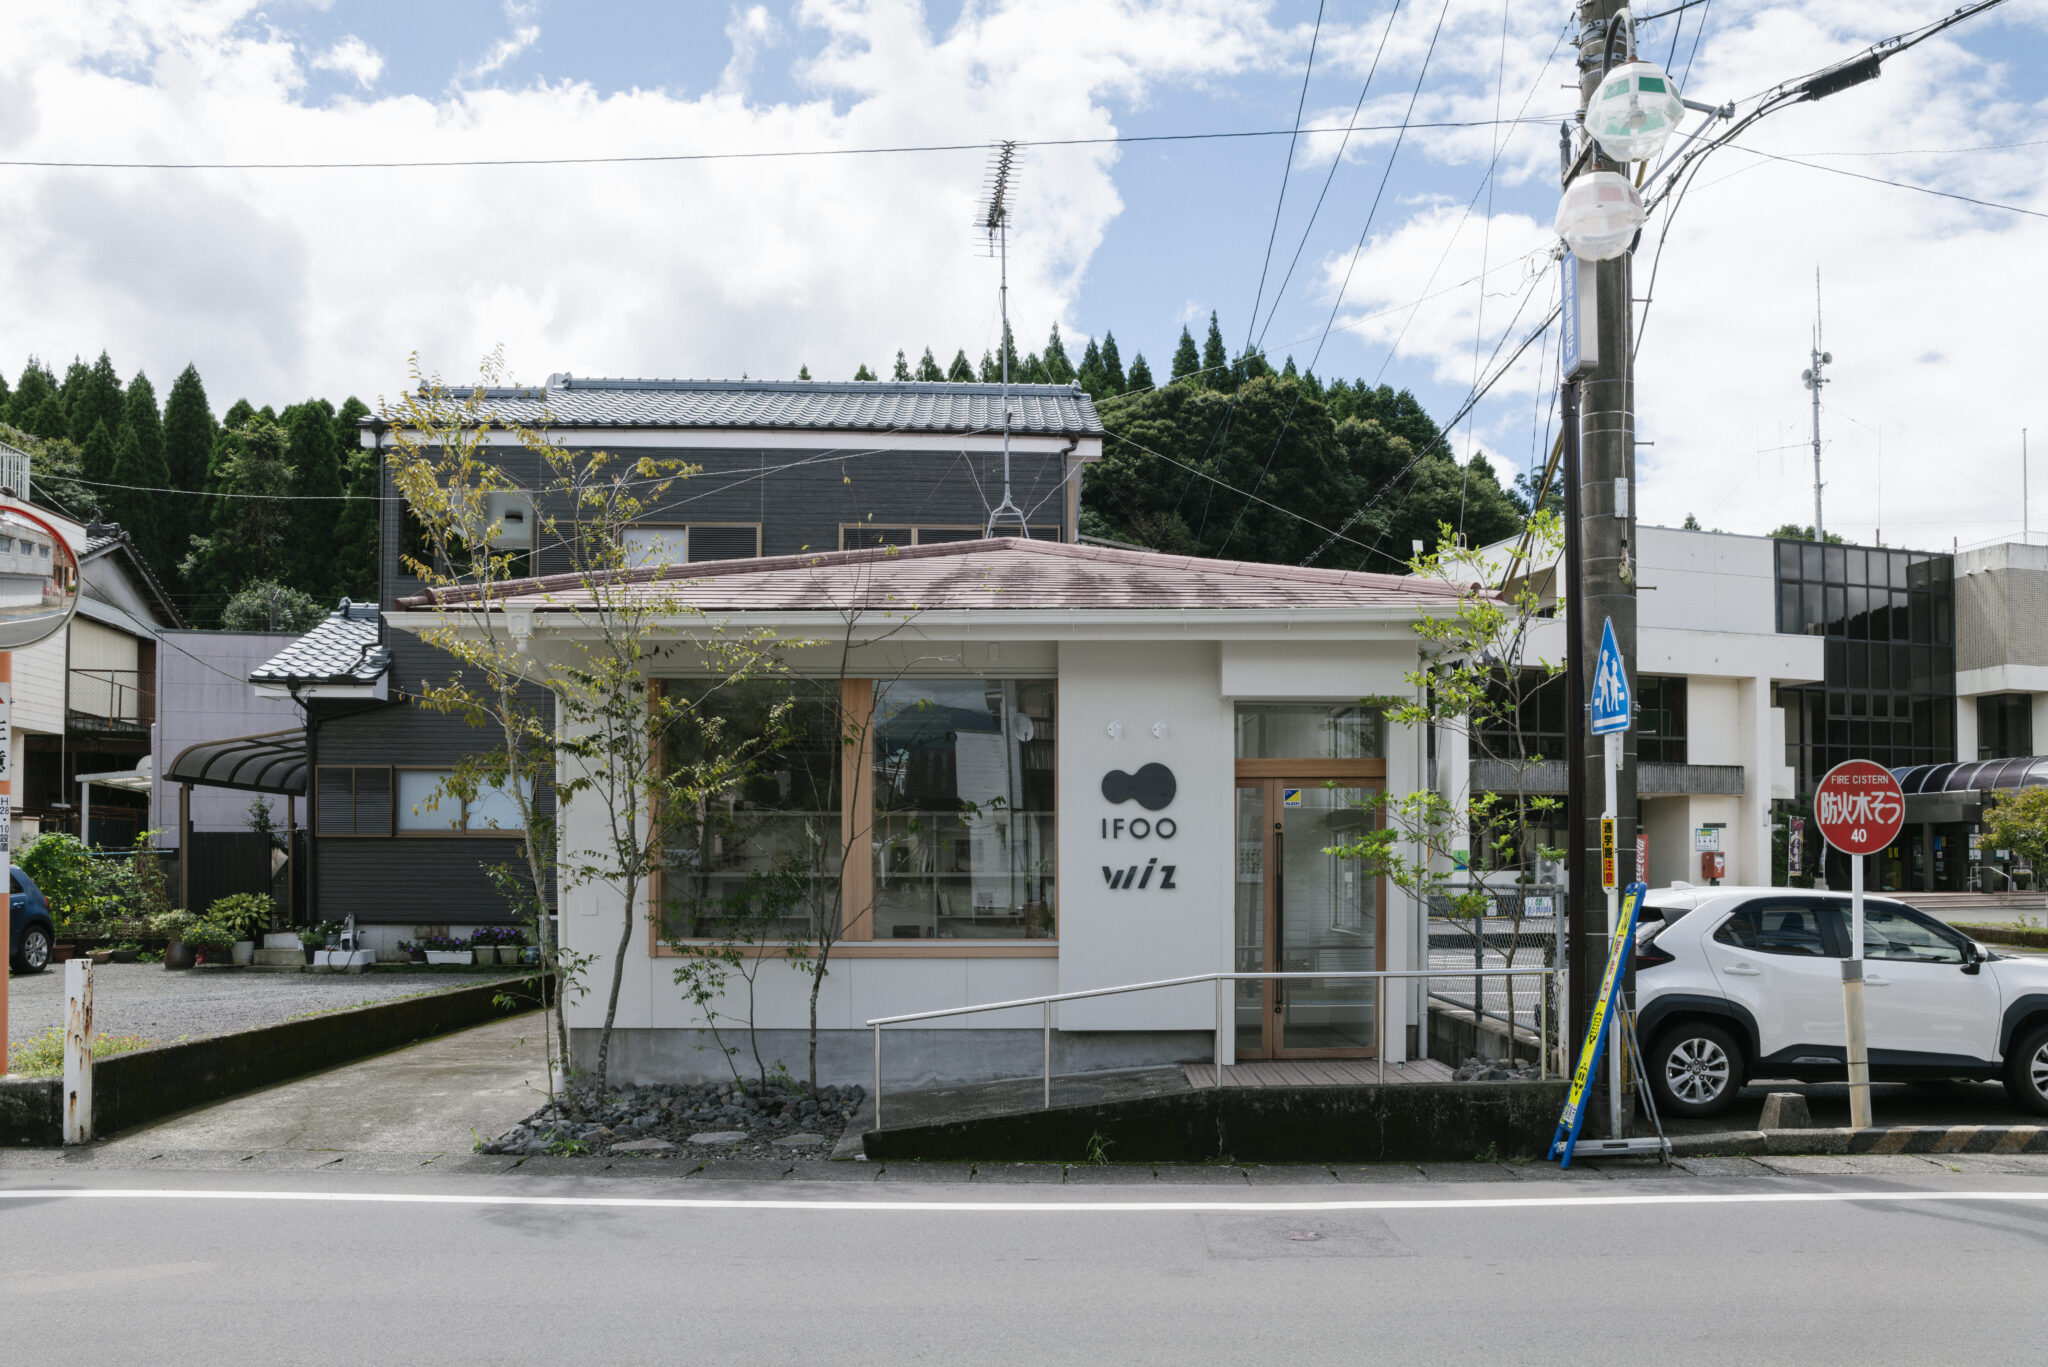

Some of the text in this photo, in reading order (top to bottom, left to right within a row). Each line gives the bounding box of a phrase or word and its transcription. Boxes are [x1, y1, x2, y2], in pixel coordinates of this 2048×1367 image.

[1831, 775, 1889, 785] FIRE CISTERN
[1102, 817, 1177, 839] IFOO
[1850, 828, 1867, 843] 40
[1603, 822, 1613, 884] 通学路注意
